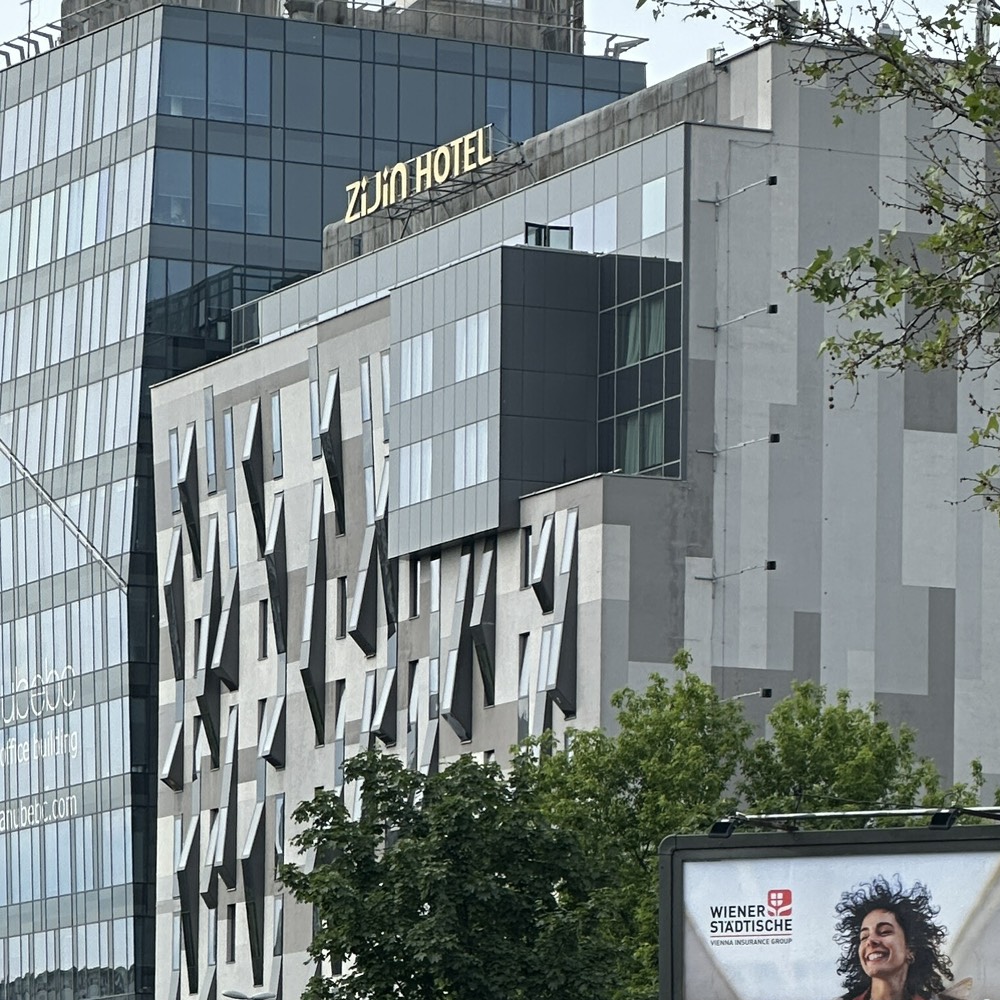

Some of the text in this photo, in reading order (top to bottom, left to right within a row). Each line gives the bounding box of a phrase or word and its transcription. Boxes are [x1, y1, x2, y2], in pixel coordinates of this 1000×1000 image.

[415, 127, 493, 194] HOTEL
[0, 728, 78, 767] office building
[710, 905, 765, 918] WIENER
[710, 919, 792, 933] STÄDTISCHE
